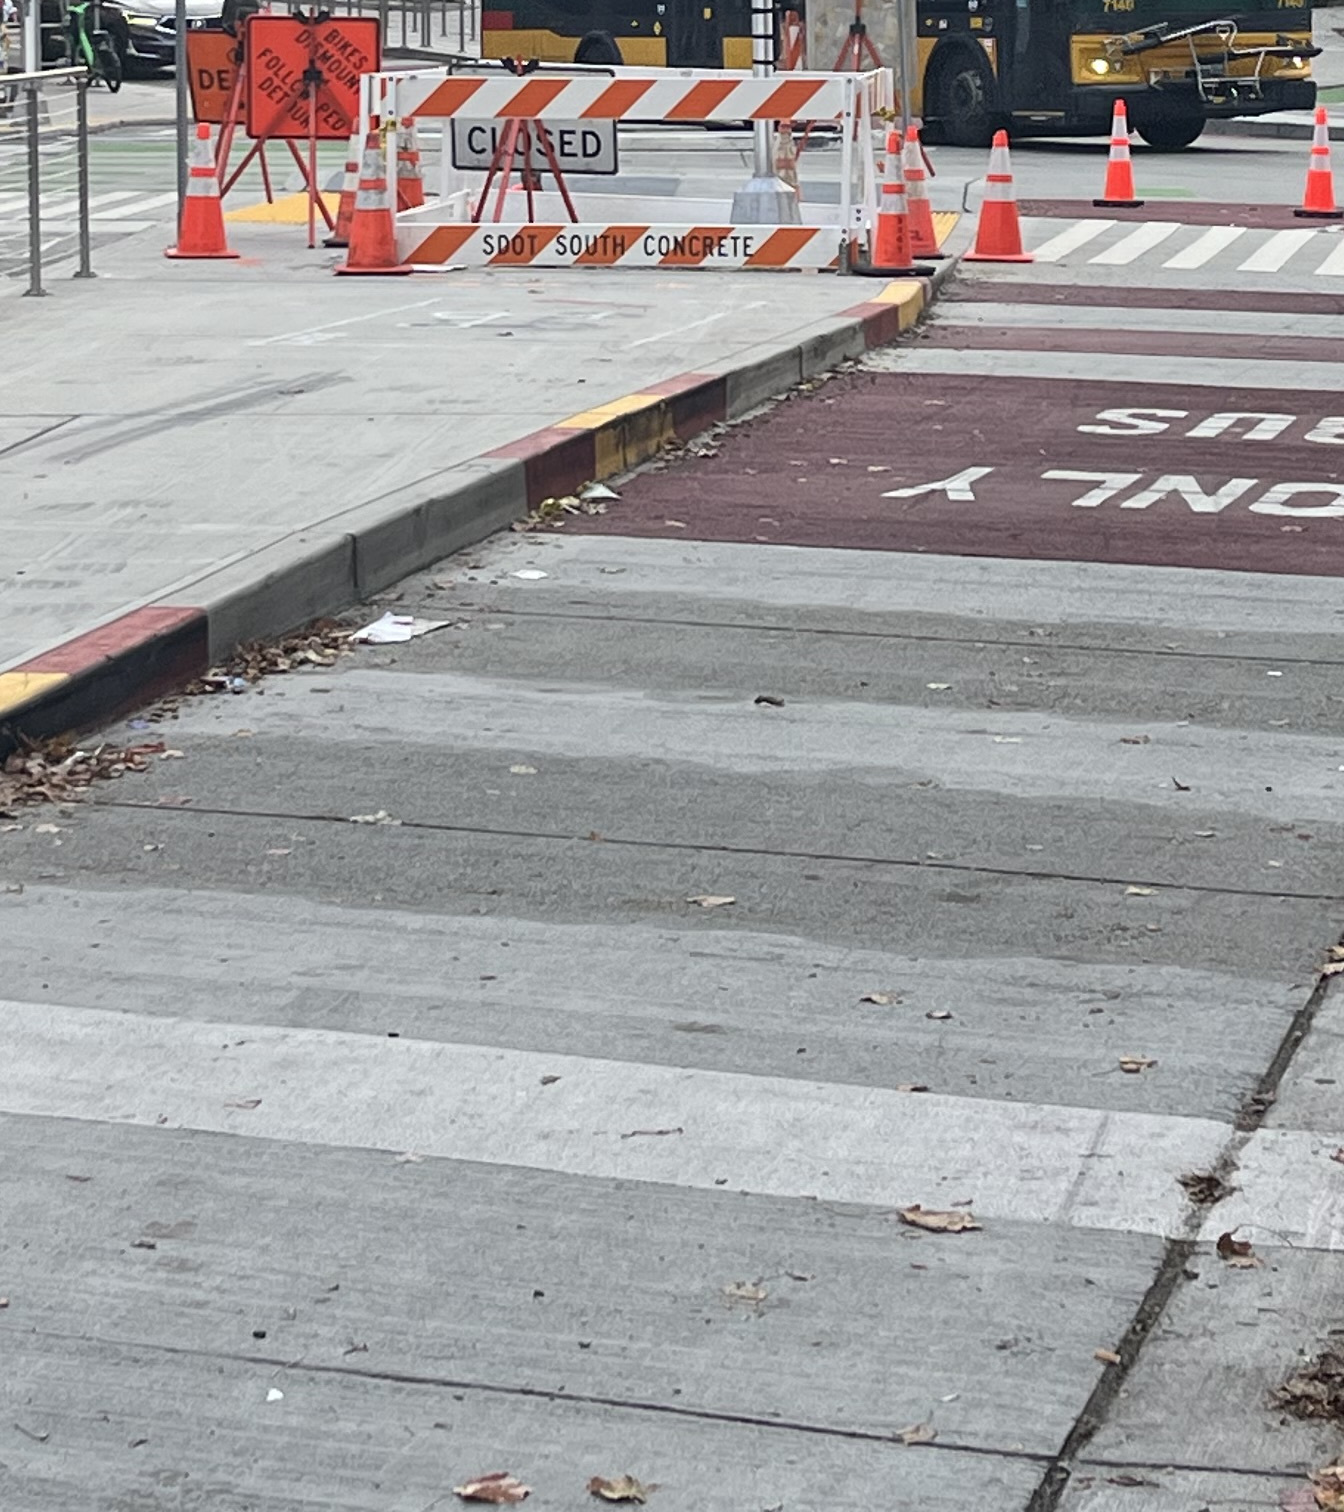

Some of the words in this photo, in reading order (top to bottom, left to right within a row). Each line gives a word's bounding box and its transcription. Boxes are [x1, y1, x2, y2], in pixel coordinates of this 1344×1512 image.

[322, 28, 369, 70] BIKES
[482, 234, 538, 257] SDOT
[555, 234, 626, 257] SOUTH
[643, 235, 754, 258] CONCRETE
